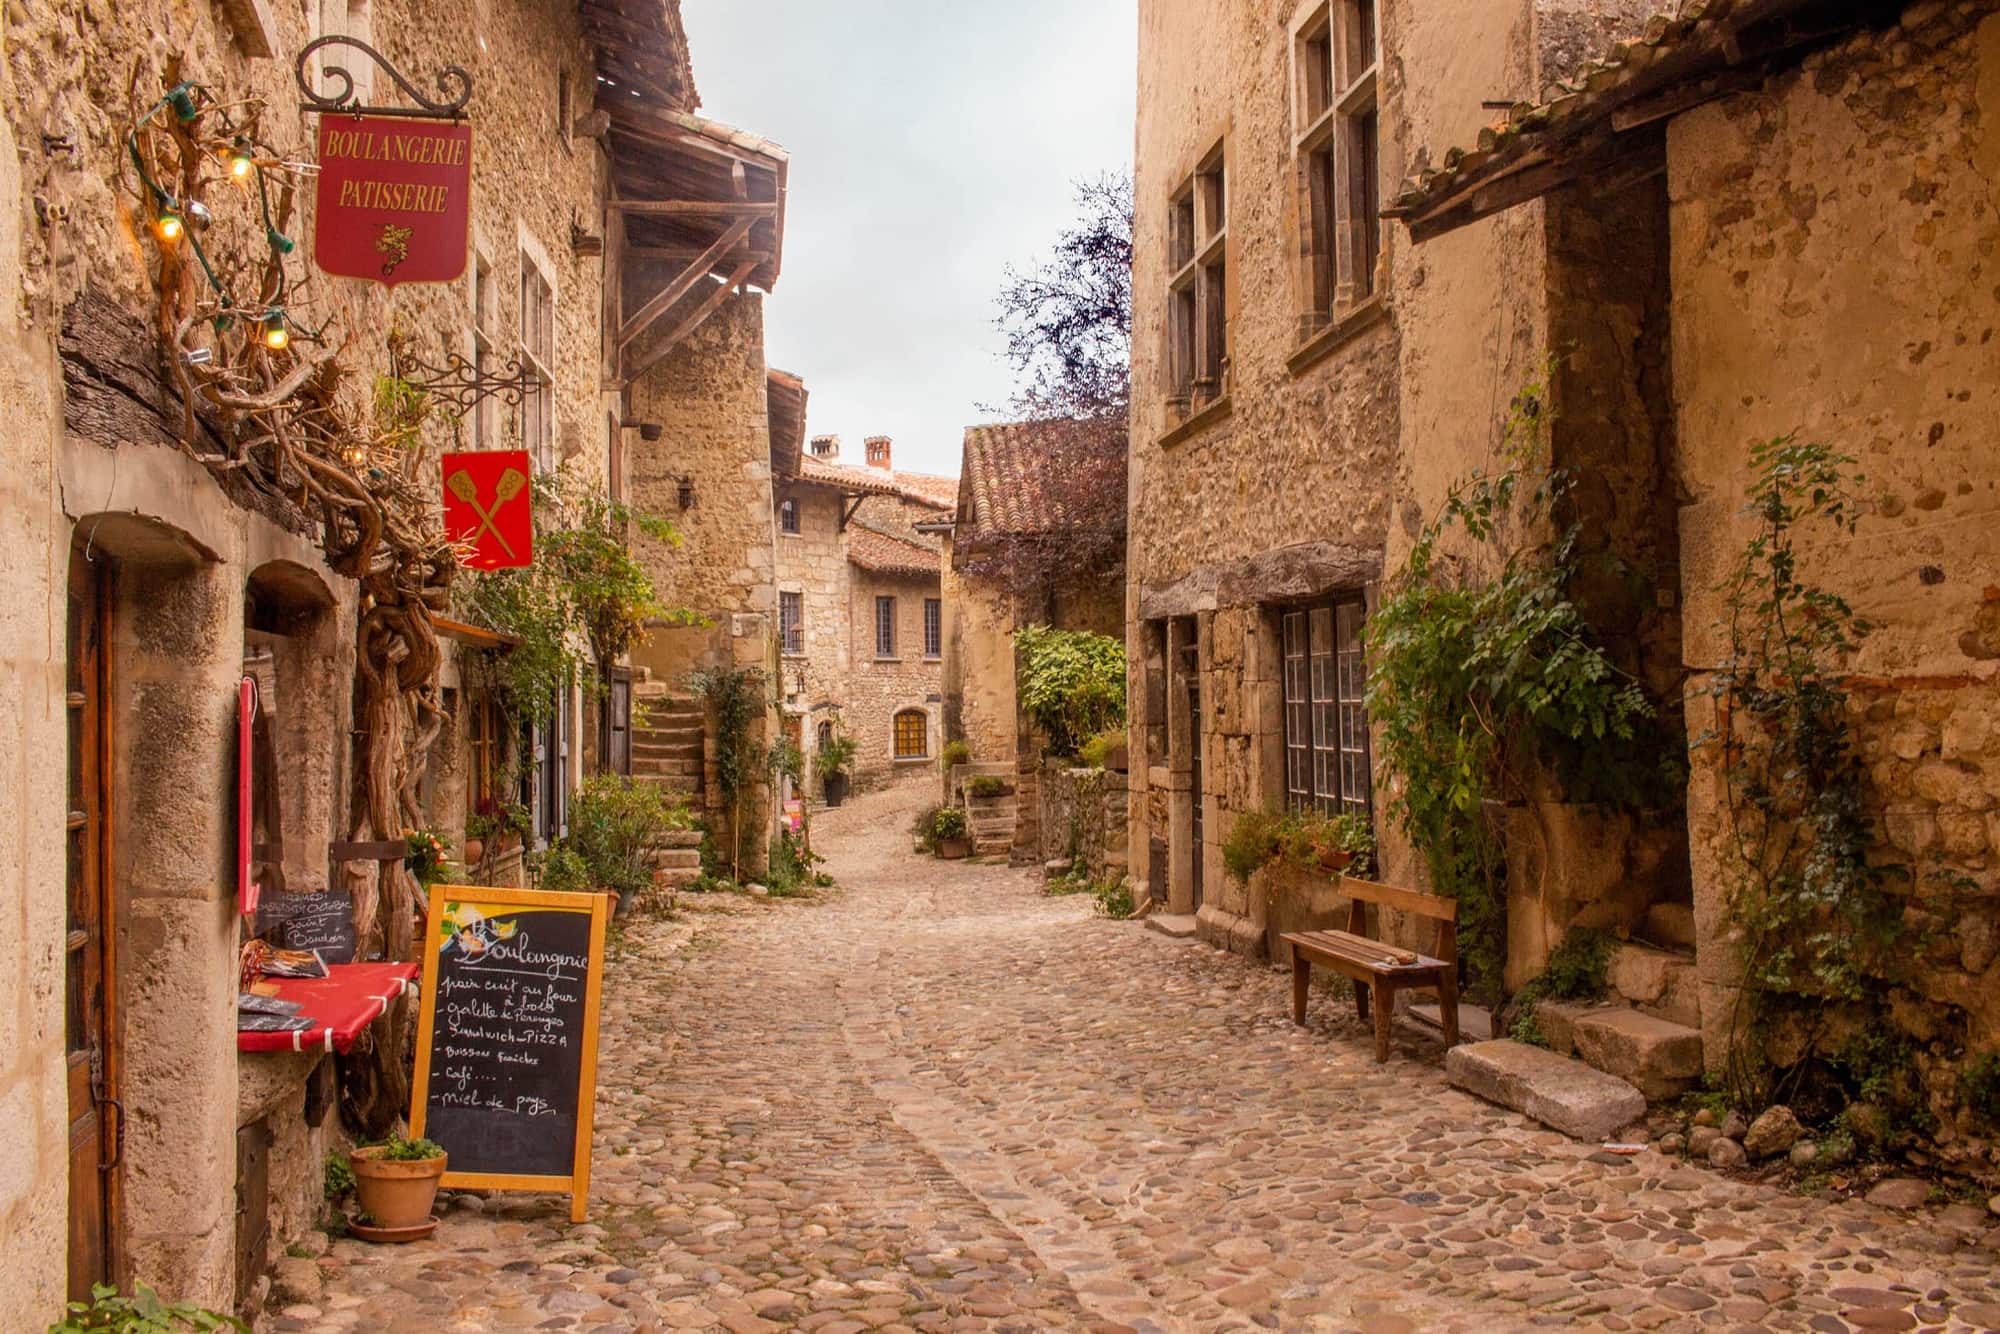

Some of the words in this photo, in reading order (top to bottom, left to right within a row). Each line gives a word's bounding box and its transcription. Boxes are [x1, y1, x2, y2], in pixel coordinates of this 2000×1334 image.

[326, 129, 467, 167] BOULANGERIE
[339, 179, 449, 213] PATISSERIE
[286, 917, 329, 931] Saint
[452, 914, 588, 980] Boulangerie
